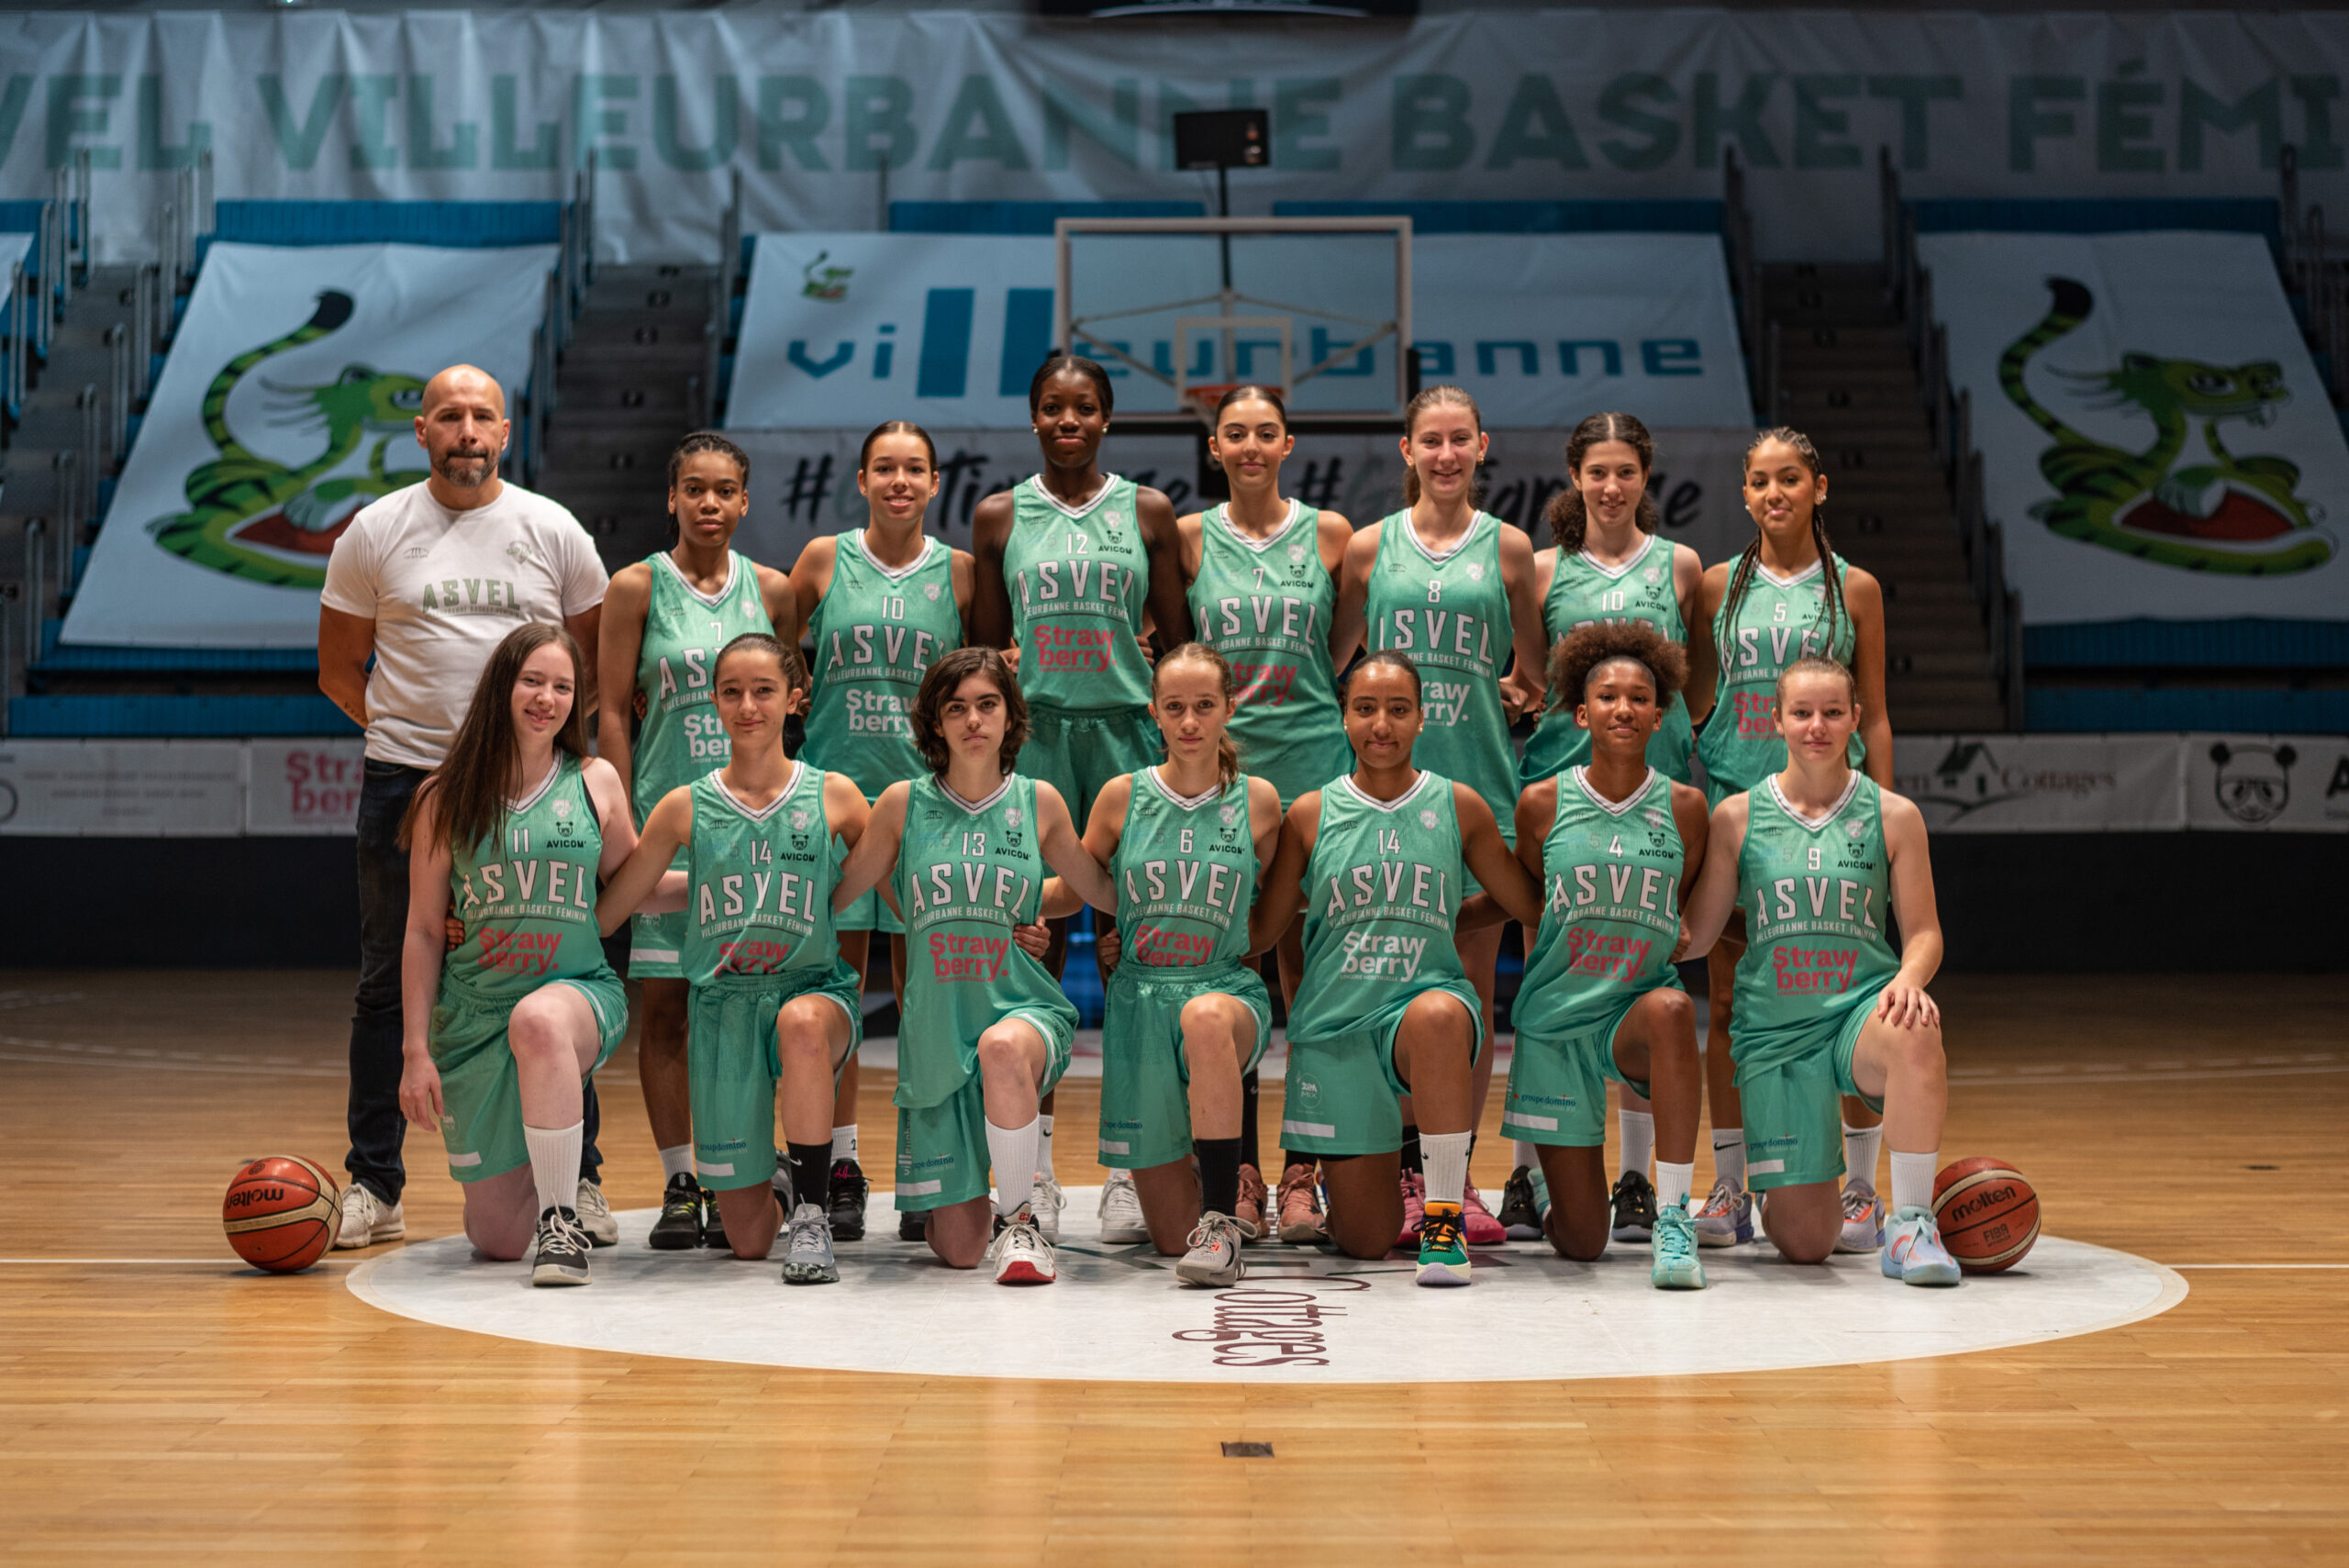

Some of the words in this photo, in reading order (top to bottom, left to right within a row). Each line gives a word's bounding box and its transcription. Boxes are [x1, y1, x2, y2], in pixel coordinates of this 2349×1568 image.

[1391, 72, 1964, 172] BASKET
[786, 288, 1704, 398] villeurbanne
[1067, 533, 1089, 554] 12
[1098, 545, 1133, 555] AVICOM
[1252, 567, 1264, 591] 7
[1280, 580, 1314, 589] AVICOM
[423, 578, 520, 614] ASVEL
[1428, 579, 1442, 604] 8
[1602, 590, 1625, 612] 10
[882, 595, 905, 620] 10
[1073, 601, 1105, 613] BASKET
[1635, 600, 1667, 613] AVICOM
[1773, 602, 1787, 623] 5
[710, 621, 723, 642] 7
[1199, 595, 1317, 647] ASVEL
[1034, 625, 1116, 647] Straw
[1255, 637, 1287, 649] BASKET
[1427, 652, 1460, 667] BASKET
[827, 667, 882, 684] VILLEURBANNE
[885, 667, 918, 682] BASKET
[512, 828, 529, 853] 11
[546, 840, 586, 849] AVICOM
[962, 831, 986, 857] 13
[1179, 828, 1194, 854] 6
[1378, 828, 1401, 855] 14
[1609, 835, 1623, 858] 4
[750, 839, 773, 866] 14
[780, 852, 818, 862] AVICOM
[995, 846, 1030, 861] AVICOM
[1639, 848, 1675, 859] AVICOM
[1807, 847, 1820, 871] 9
[1838, 860, 1876, 871] AVICOM
[462, 859, 589, 910] ASVEL
[912, 862, 1030, 918] ASVEL
[1552, 863, 1675, 921] ASVEL
[699, 870, 817, 927] ASVEL
[1756, 875, 1877, 930] ASVEL
[518, 904, 552, 917] BASKET
[556, 906, 588, 923] FEMININ
[751, 913, 784, 926] BASKET
[966, 906, 999, 920] BASKET
[1176, 903, 1210, 917] BASKET
[1384, 906, 1417, 919] BASKET
[1419, 911, 1450, 931] FEMININ
[1609, 906, 1643, 919] BASKET
[1810, 920, 1846, 933] BASKET
[478, 927, 562, 951] Straw
[929, 932, 1010, 956] Straw
[1342, 930, 1428, 956] Straw
[1566, 926, 1653, 956] Straw
[1772, 946, 1859, 969] Straw
[1545, 1094, 1576, 1106] domino
[226, 1188, 284, 1209] molten
[1952, 1185, 2018, 1222] molten
[1983, 1223, 2010, 1242] FIBA
